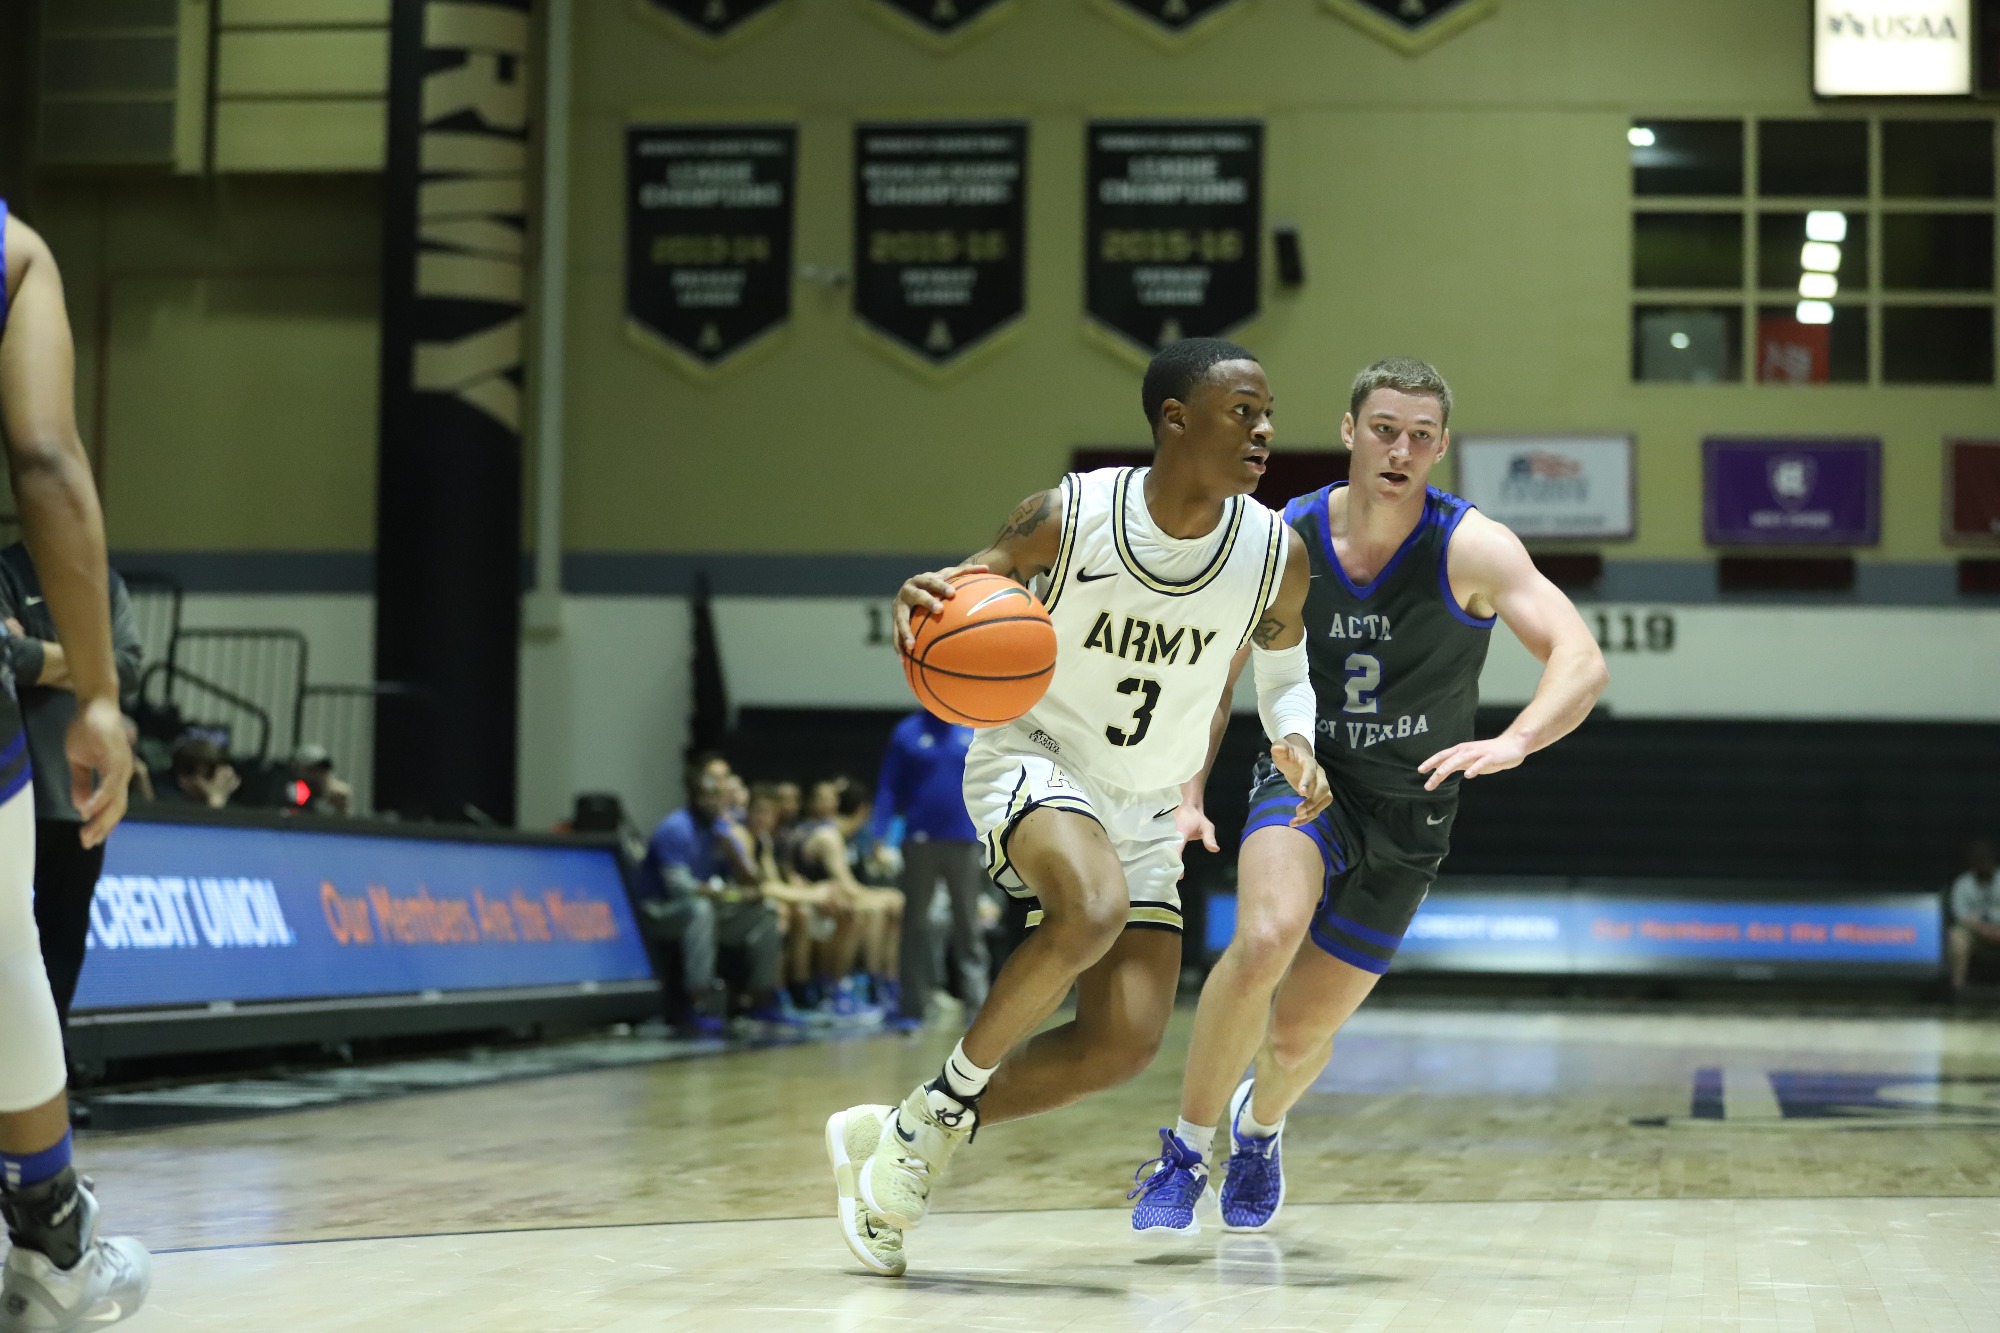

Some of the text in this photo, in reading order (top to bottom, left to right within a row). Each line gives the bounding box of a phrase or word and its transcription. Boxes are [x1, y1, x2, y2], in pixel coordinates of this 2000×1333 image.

[1872, 14, 1957, 41] USAA
[1081, 609, 1220, 666] ARMY
[1328, 613, 1392, 641] ACTA
[1103, 675, 1163, 747] 3
[1342, 651, 1382, 715] 2
[89, 875, 198, 950] CREDIT
